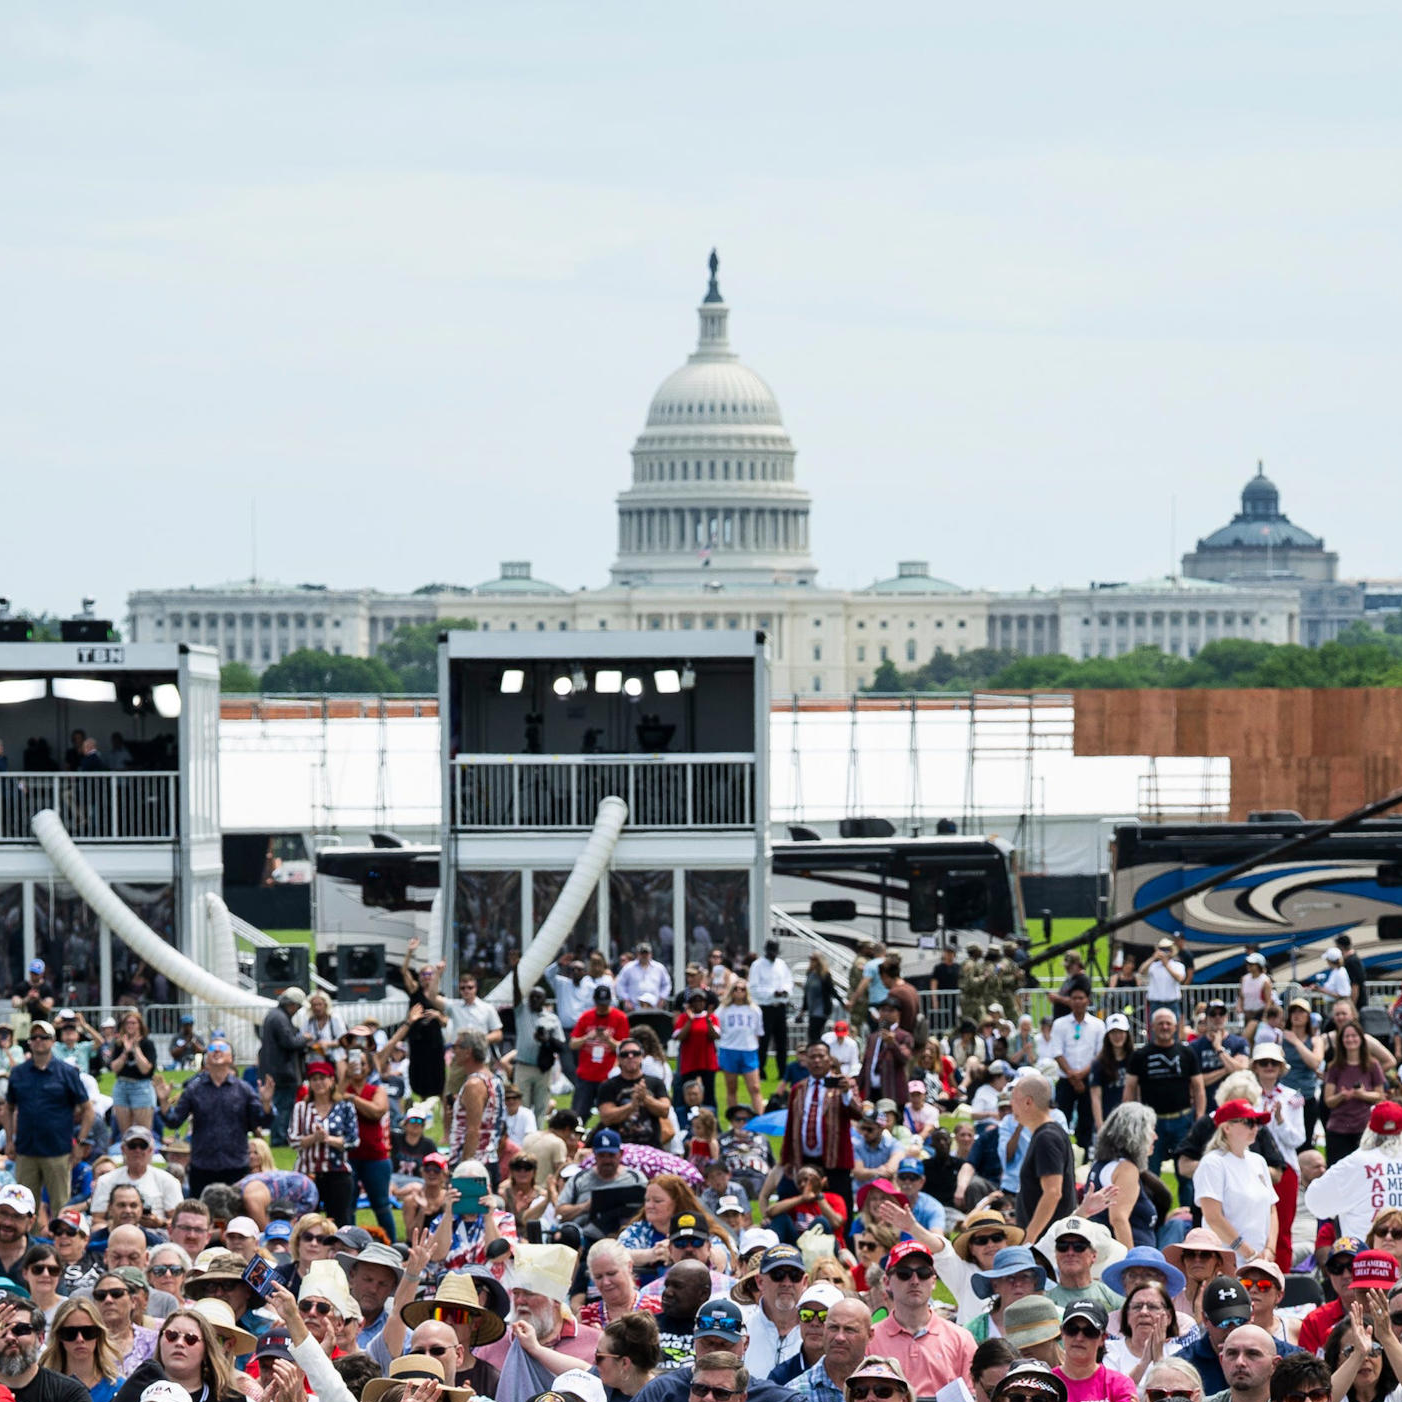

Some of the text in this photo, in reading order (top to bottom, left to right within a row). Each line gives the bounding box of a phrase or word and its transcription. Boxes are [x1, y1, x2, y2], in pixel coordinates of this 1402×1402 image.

[77, 647, 124, 664] TBN
[1353, 1261, 1392, 1270] MAKE AMERICA
[1355, 1269, 1390, 1277] GREAT AGAIN
[147, 1386, 172, 1395] USA
